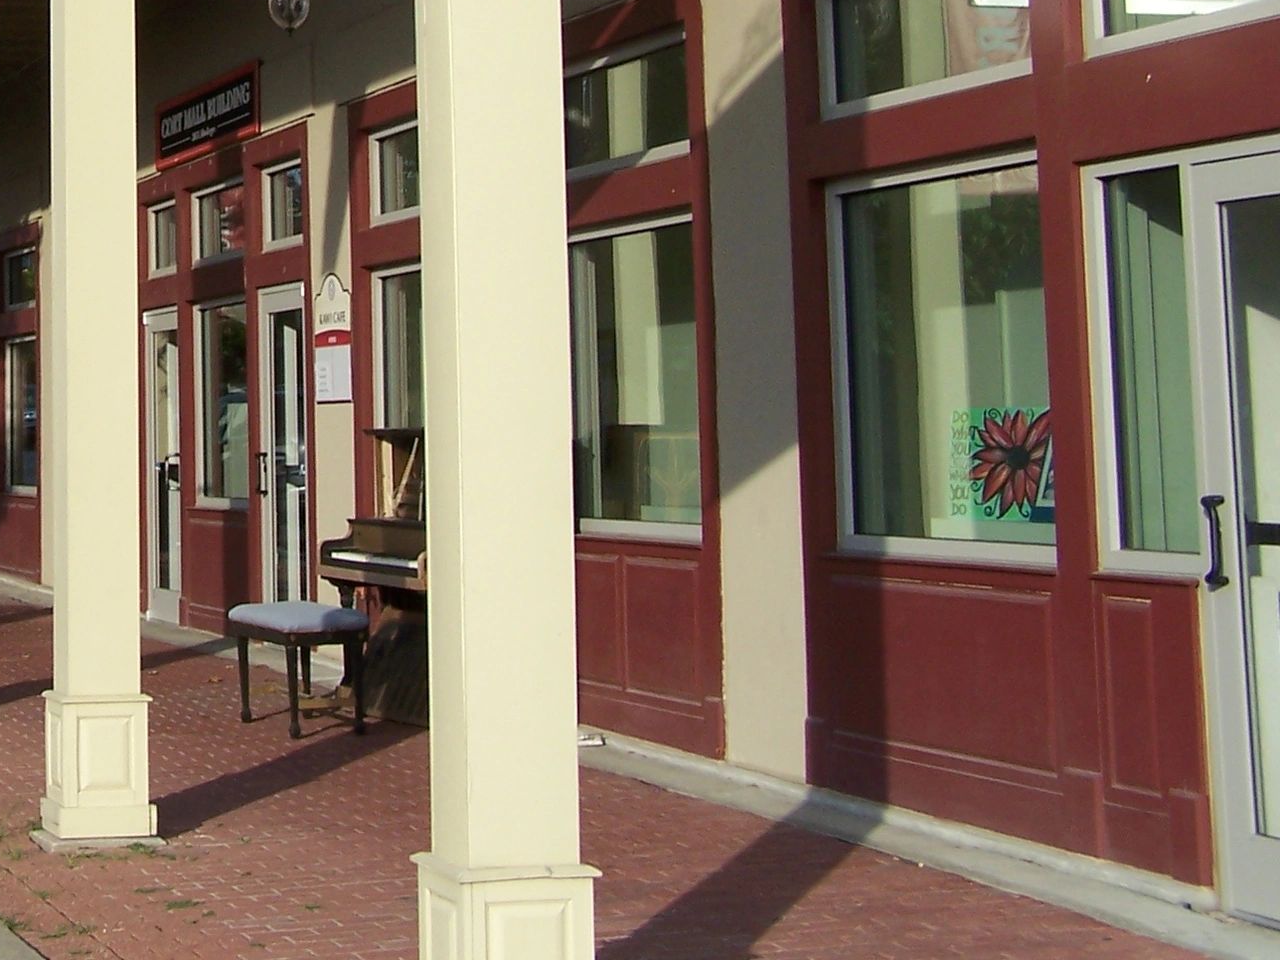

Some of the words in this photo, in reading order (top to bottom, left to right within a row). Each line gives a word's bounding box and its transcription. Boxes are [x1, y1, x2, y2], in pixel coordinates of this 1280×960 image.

[206, 81, 251, 121] BUILDING
[952, 410, 969, 423] DO
[950, 483, 969, 502] YOU
[951, 503, 968, 517] DO
